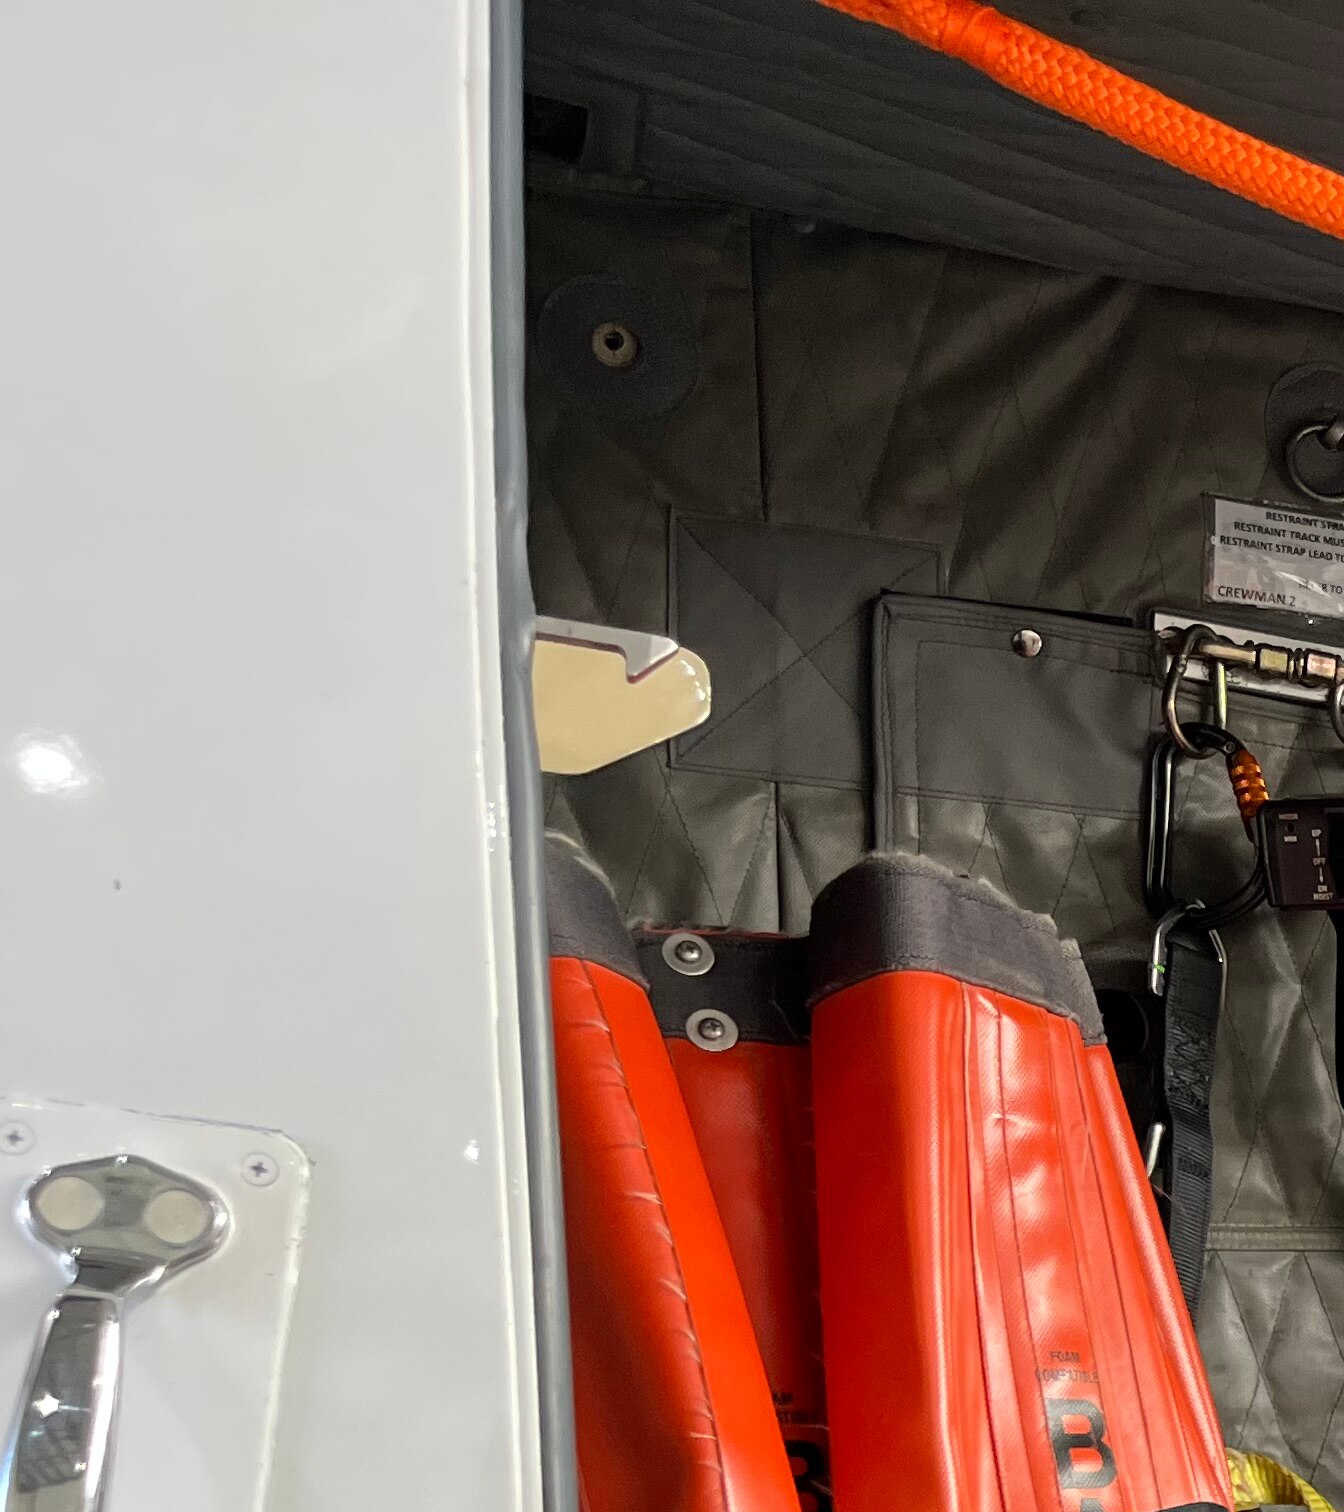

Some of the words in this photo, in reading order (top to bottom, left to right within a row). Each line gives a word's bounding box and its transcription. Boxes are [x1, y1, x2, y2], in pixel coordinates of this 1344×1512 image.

[1266, 511, 1317, 528] RESTRAINT
[1234, 521, 1286, 538] RESTRAINT
[1290, 530, 1320, 544] TRACK
[1219, 535, 1272, 552] RESTRAINT
[1275, 543, 1306, 557] STRAP
[1309, 550, 1333, 562] LEAD
[1218, 584, 1288, 605] CREWMAN
[1330, 583, 1343, 595] TO
